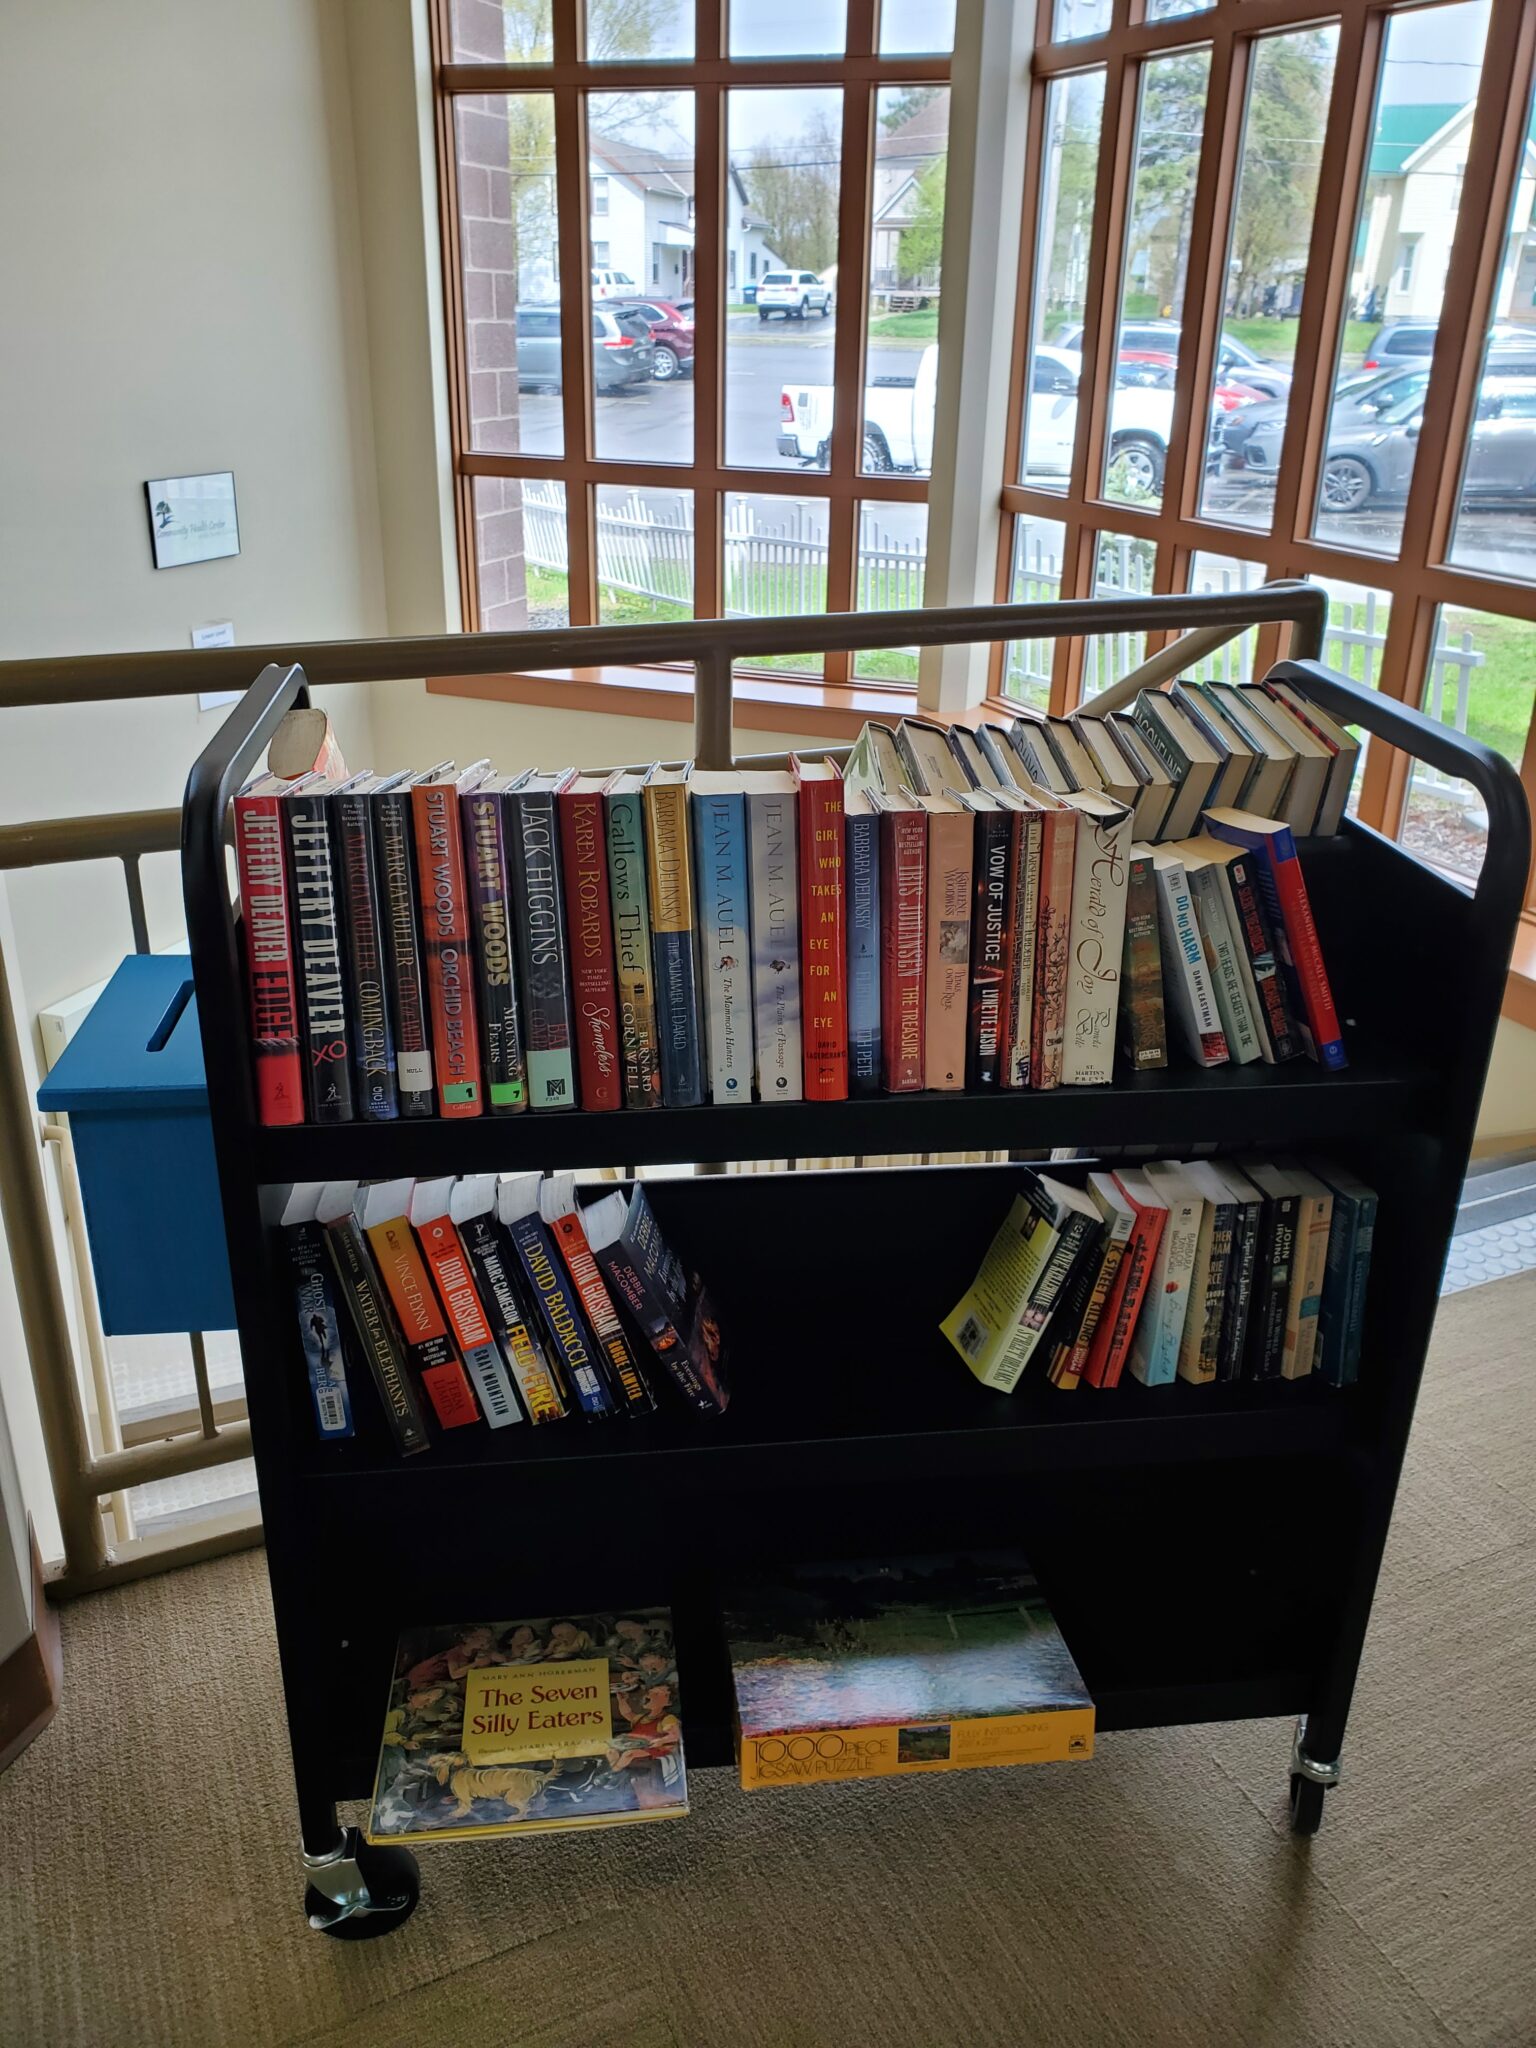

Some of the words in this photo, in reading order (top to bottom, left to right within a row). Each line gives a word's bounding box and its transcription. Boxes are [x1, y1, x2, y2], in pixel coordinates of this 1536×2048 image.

[426, 791, 448, 857] STUART
[654, 790, 678, 857] BARBARA
[824, 802, 842, 813] THE
[472, 800, 501, 894] STUART
[521, 802, 552, 860] JACK
[574, 802, 596, 863] KAREN
[710, 802, 731, 857] JEAN
[761, 802, 782, 857] JEAN
[816, 830, 837, 841] GIRL
[243, 810, 282, 895] JEFFERY
[345, 833, 370, 903] MARCIA
[384, 830, 406, 898] MARCIA
[610, 803, 635, 900] Gallows
[818, 857, 842, 868] WHO
[854, 823, 871, 875] BARBARA
[990, 845, 1005, 879] VOW
[1027, 843, 1040, 890] MARSHAL
[290, 813, 334, 926] JEFFERY
[715, 870, 732, 888] M.
[767, 870, 784, 888] M.
[898, 865, 924, 897] IRIS
[955, 870, 969, 907] KATHLEEN
[1088, 826, 1126, 923] Herald
[432, 862, 456, 937] WOODS
[658, 858, 682, 926] DELINSKY
[811, 885, 842, 896] TAKES
[854, 876, 872, 930] DELINSKY
[988, 880, 1004, 900] OF
[1176, 895, 1189, 912] DO
[250, 894, 288, 963] DEAVER
[391, 897, 415, 968] MULLER
[525, 865, 559, 966] HIGGINS
[578, 870, 602, 958] ROBARDS
[717, 893, 734, 951] AUEL
[769, 893, 785, 948] AUEL
[820, 912, 834, 923] AN
[985, 903, 1003, 962] JUSTICE
[1082, 918, 1103, 940] of
[1176, 913, 1189, 928] NO
[350, 904, 375, 971] MULLER
[481, 900, 510, 988] WOODS
[618, 904, 645, 975] Thief
[666, 941, 678, 956] THE
[809, 939, 829, 950] EYE
[897, 901, 923, 977] JOHANSEN
[1022, 922, 1038, 971] MURDERER
[1179, 929, 1201, 965] HARM
[1217, 941, 1230, 957] TWO
[1297, 887, 1315, 943] ALEXANDER
[1320, 979, 1332, 1011] SMITH
[440, 948, 461, 1019] ORCHID
[667, 958, 684, 1004] SUMMER
[722, 978, 732, 992] The
[810, 965, 830, 976] FOR
[1076, 938, 1118, 995] Joy
[1192, 970, 1204, 992] DAWN
[1220, 957, 1234, 978] HEADS
[1224, 978, 1237, 992] ARE
[253, 970, 294, 1039] EDGE
[301, 939, 346, 1035] DEAVER
[776, 984, 785, 1000] The
[823, 991, 837, 1002] AN
[901, 985, 919, 1006] THE
[1228, 992, 1243, 1018] DEADER
[358, 980, 383, 1042] COMING
[723, 994, 733, 1036] Mammoth
[776, 1001, 785, 1028] Plains
[814, 1017, 833, 1028] EYE
[981, 989, 999, 1026] LYNETTE
[1197, 994, 1212, 1028] EASTMAN
[1235, 1018, 1248, 1034] THAN
[487, 1023, 502, 1064] FEARS
[502, 1006, 517, 1077] MOUNTING
[582, 1002, 615, 1078] Shameless
[622, 1002, 640, 1092] CORNWELL
[670, 1013, 687, 1051] DARED
[901, 1008, 919, 1060] TREASURE
[979, 1026, 998, 1057] EASON
[1077, 1009, 1093, 1048] Belle
[1092, 1008, 1111, 1048] Pamela
[1241, 1035, 1253, 1048] ONE
[366, 1038, 387, 1078] BACK
[445, 1018, 466, 1077] BEACH
[639, 1031, 652, 1092] BERNARD
[725, 1036, 733, 1069] Hunters
[776, 1040, 785, 1068] Passage
[857, 1051, 873, 1077] PETE
[1110, 1243, 1123, 1253] K
[1168, 1231, 1181, 1275] BRADFORD
[1177, 1236, 1187, 1268] TAYLOR
[1185, 1233, 1196, 1271] BARBARA
[1273, 1223, 1284, 1264] IRVING
[1283, 1227, 1292, 1260] JOHN
[436, 1256, 468, 1292] JOHN
[482, 1256, 502, 1284] MARC
[568, 1251, 600, 1287] JOHN
[607, 1261, 643, 1311] MACOMBER
[623, 1266, 647, 1297] DEBBIE
[1096, 1255, 1118, 1296] STREET
[299, 1284, 316, 1314] WAR
[310, 1272, 327, 1312] GHOST
[394, 1253, 418, 1293] VINCE
[408, 1293, 432, 1332] FLYNN
[491, 1280, 522, 1326] CAMERON
[523, 1243, 557, 1291] DAVID
[544, 1290, 590, 1367] BALDACCI
[581, 1279, 623, 1337] GRISHAM
[448, 1288, 487, 1345] GRISHAM
[1079, 1295, 1106, 1345] KILLING
[356, 1279, 379, 1328] WATER
[374, 1340, 410, 1417] ELEPHANTS
[474, 1349, 493, 1374] GRAY
[607, 1339, 630, 1373] ROGUE
[1008, 1329, 1034, 1359] STREET
[507, 1324, 537, 1367] FIELD
[522, 1371, 562, 1424] FIRE
[618, 1366, 644, 1401] LAWYER
[670, 1361, 679, 1372] by
[675, 1370, 687, 1383] the
[683, 1381, 696, 1398] Fire
[681, 1359, 702, 1391] Evenings
[994, 1355, 1024, 1386] DREAMS
[433, 1379, 451, 1417] LIMITS
[449, 1379, 465, 1411] TERM
[482, 1372, 509, 1416] MOUNTAIN
[512, 1671, 534, 1680] ANN
[539, 1667, 596, 1677] HOBERMAN
[480, 1689, 524, 1708] The
[530, 1684, 598, 1704] Seven
[471, 1713, 520, 1737] Silly
[528, 1710, 604, 1731] Eaters
[957, 1728, 982, 1739] FULLY
[984, 1723, 1049, 1737] INTERLOCKING
[750, 1733, 845, 1764] 1000
[845, 1738, 890, 1757] PIECE
[750, 1760, 812, 1781] JIGSAW
[814, 1756, 875, 1775] PUZZLE
